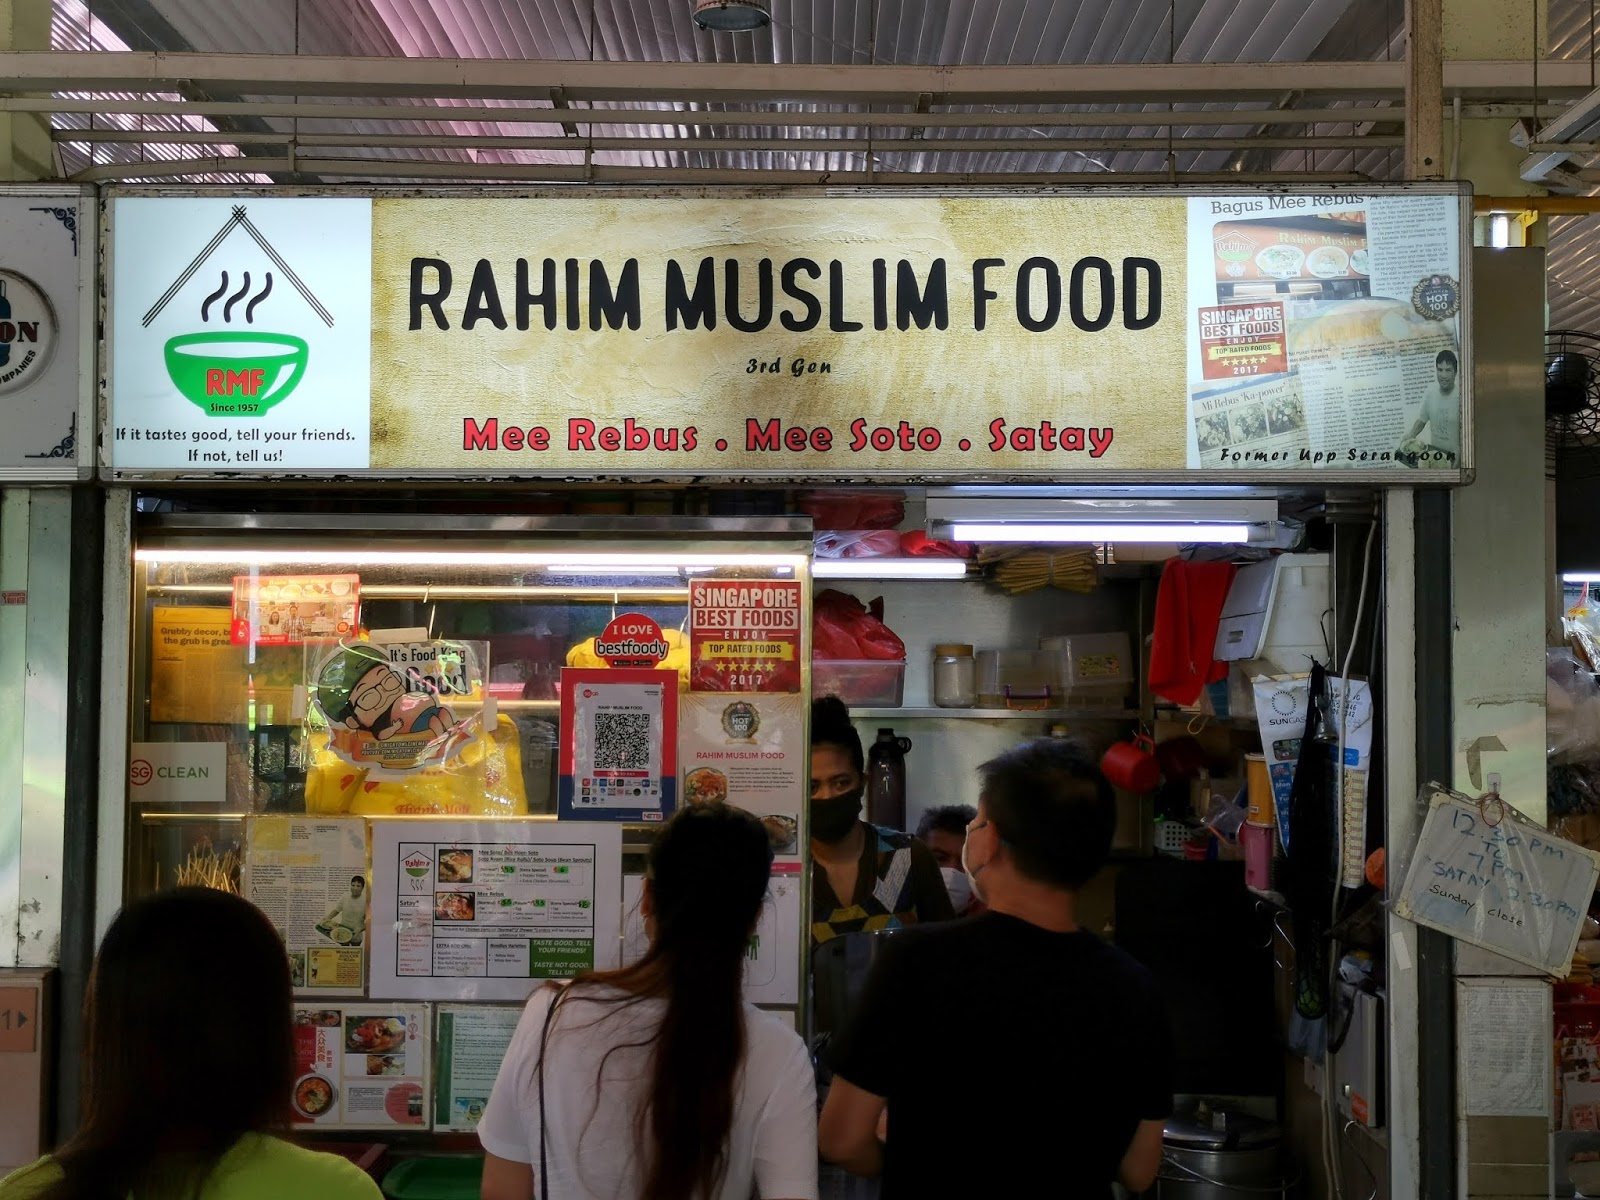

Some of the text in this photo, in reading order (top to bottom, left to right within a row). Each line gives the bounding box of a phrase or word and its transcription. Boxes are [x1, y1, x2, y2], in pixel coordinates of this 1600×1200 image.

[1211, 195, 1364, 215] Bagus Mee Rebus
[1279, 232, 1316, 245] Rahim
[1321, 235, 1357, 247] Muslim
[408, 256, 1162, 333] RAHIM MUSLIM FOOD
[1426, 294, 1449, 303] HOT
[1429, 302, 1448, 311] 100
[1201, 306, 1282, 325] SINGAPORE
[1204, 320, 1280, 338] BEST FOODS
[1226, 336, 1261, 345] ENJOY
[1229, 346, 1250, 354] RATED
[1250, 344, 1272, 352] FOODS
[0, 349, 37, 385] MPANIES
[745, 357, 833, 377] 3rd Gen
[1233, 365, 1259, 375] 2017
[206, 368, 266, 397] RMF
[210, 402, 259, 413] Since 1957
[1214, 396, 1239, 409] Rebus
[116, 428, 356, 445] If it tastes good, tell your friends.
[463, 417, 1115, 459] Mee Rebus Mee Soto Satay
[188, 450, 283, 465] If not, tell us!
[1220, 448, 1289, 462] Former
[1299, 448, 1338, 464] Upp
[1347, 448, 1457, 464] Serangoon
[694, 587, 798, 608] SINGAPORE
[696, 610, 794, 627] BEST FOODS
[160, 627, 222, 637] Grubby decor,
[613, 625, 653, 635] I LOVE
[724, 630, 768, 640] ENJOY
[180, 637, 200, 646] grub
[202, 637, 210, 645] is
[211, 638, 231, 647] grea
[597, 639, 667, 658] bestfoody
[709, 644, 782, 654] TOP RATED FOODS
[390, 649, 407, 662] It's
[411, 647, 436, 662] Food
[730, 674, 763, 686] 2017
[732, 717, 750, 725] HOT
[760, 752, 785, 760] FOOD
[131, 766, 209, 779] SG CLEAN
[1429, 884, 1476, 915] Sunday
